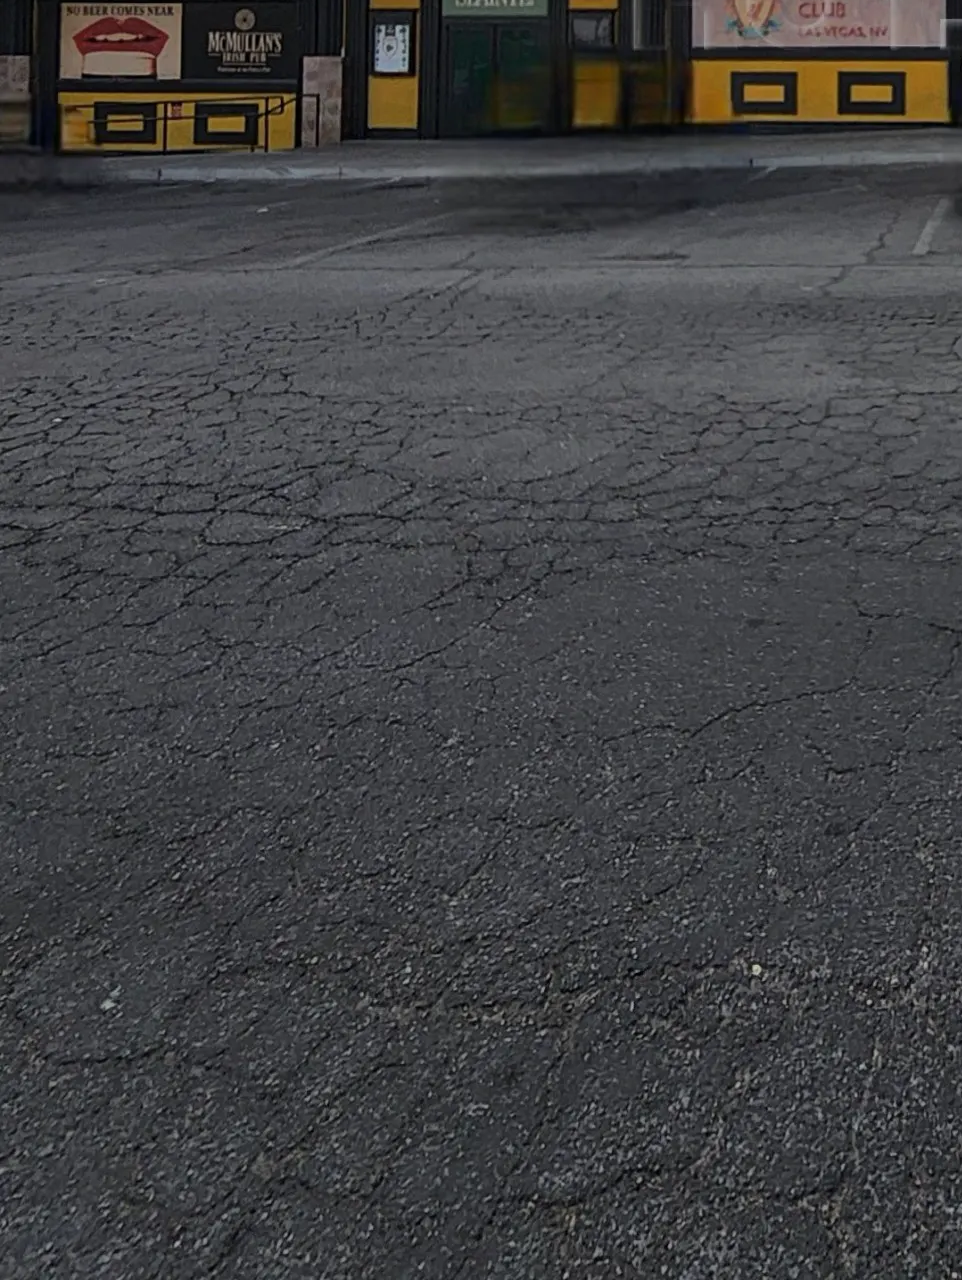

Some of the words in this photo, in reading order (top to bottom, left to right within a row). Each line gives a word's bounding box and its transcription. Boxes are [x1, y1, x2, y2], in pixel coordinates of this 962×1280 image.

[83, 5, 108, 16] BEER
[110, 5, 145, 16] COMES
[147, 5, 175, 16] NEAR
[798, 2, 846, 18] CLUB
